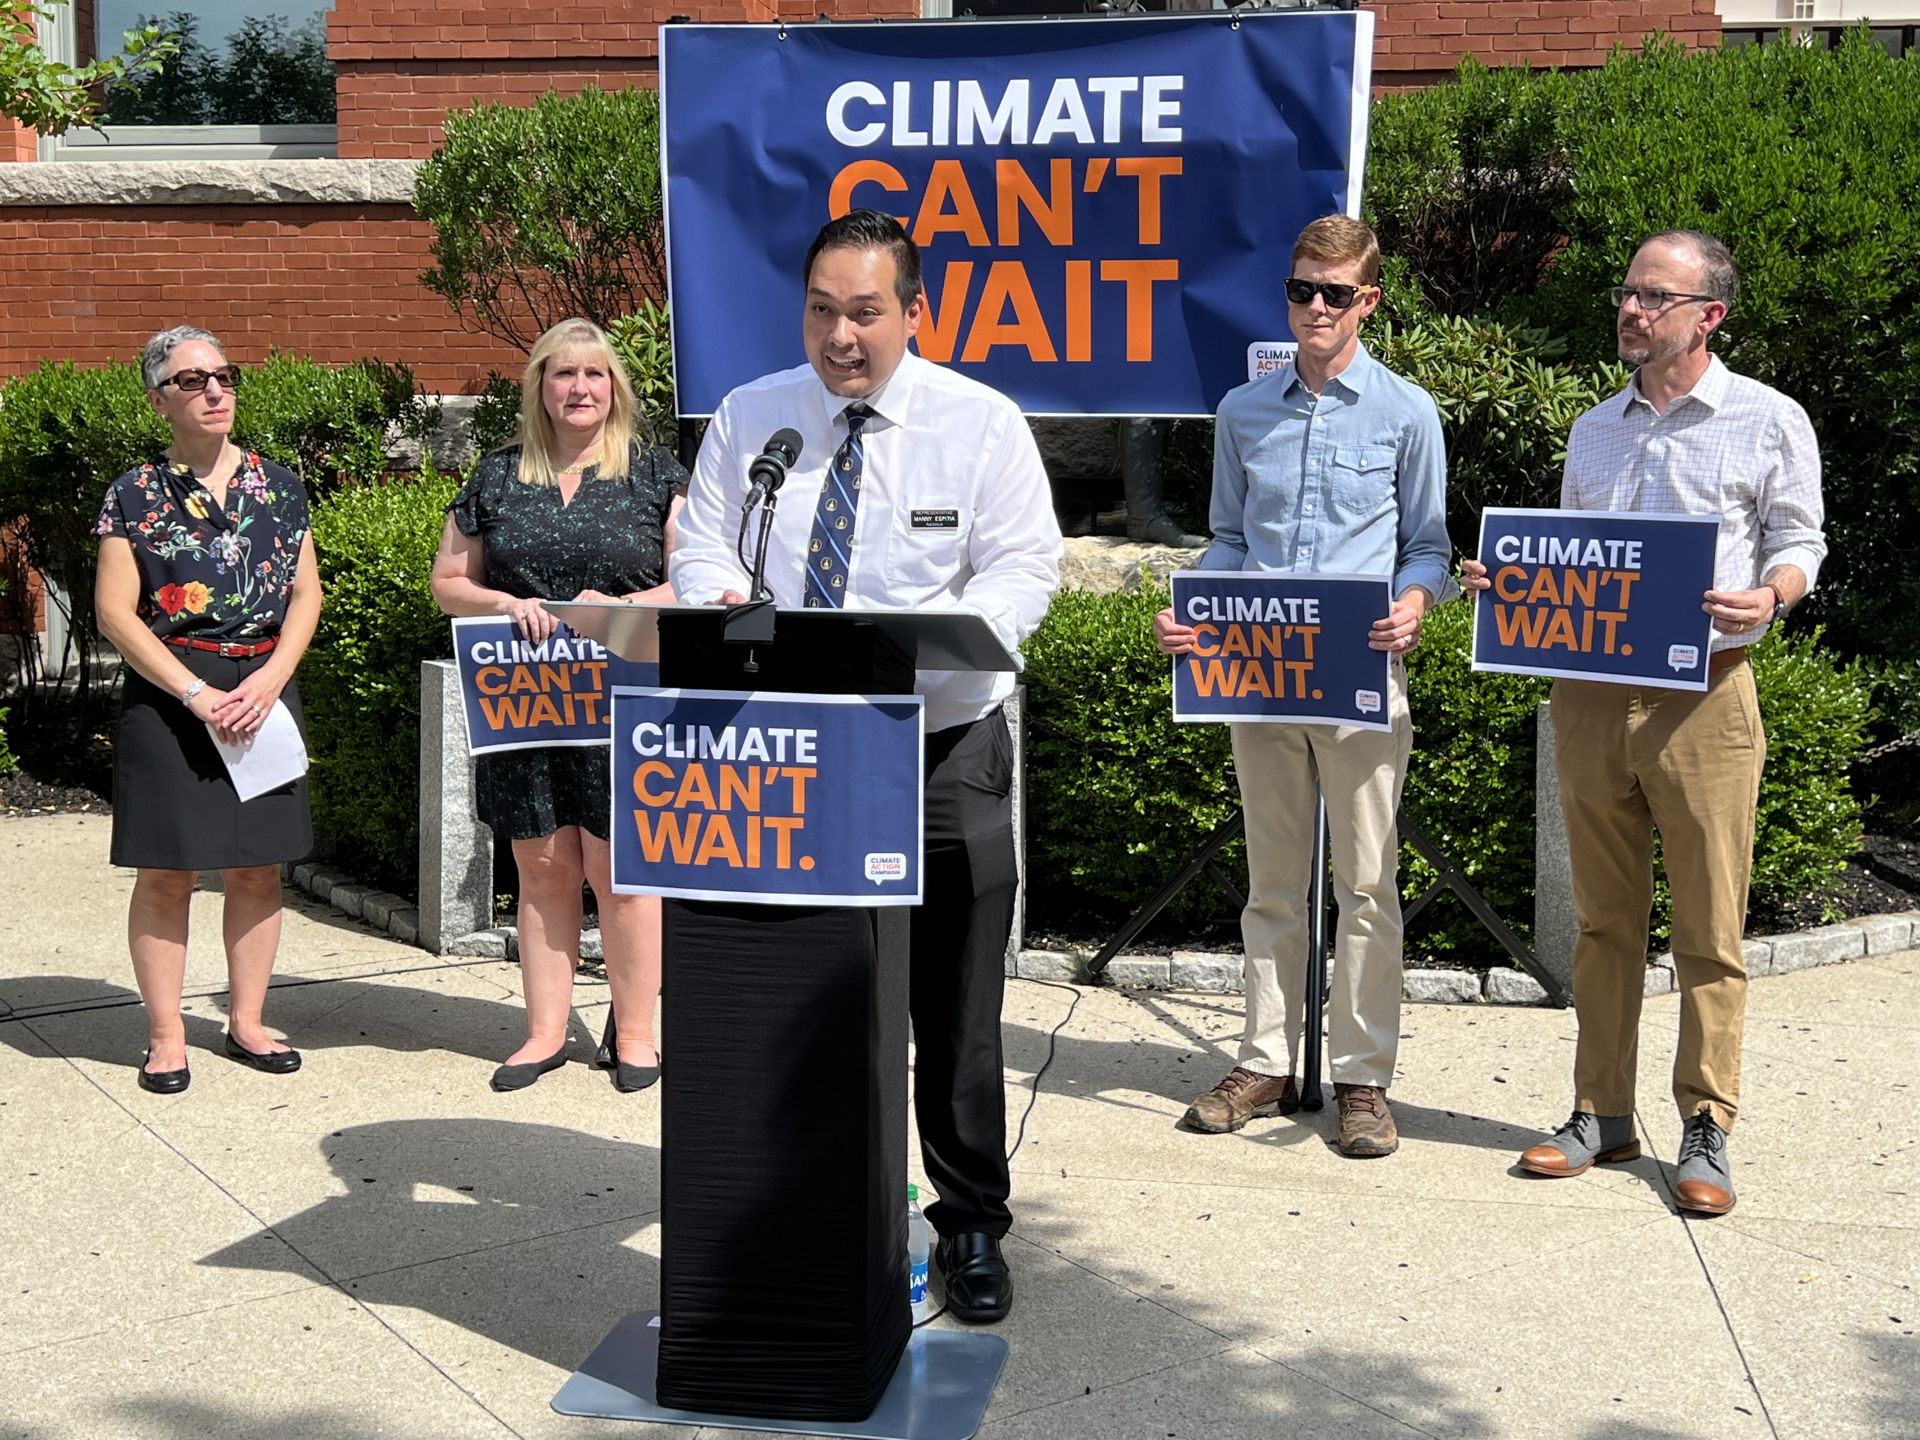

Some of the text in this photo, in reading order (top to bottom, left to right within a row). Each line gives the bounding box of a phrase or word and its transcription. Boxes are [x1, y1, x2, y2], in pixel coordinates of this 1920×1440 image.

[826, 75, 1184, 147] CLIMATE
[828, 157, 1183, 247] CAN'T
[1256, 350, 1298, 360] CLIMAT
[1495, 535, 1643, 569] CLIMATE
[1494, 565, 1641, 610] CAN'T
[1187, 596, 1320, 624] CLIMATE
[1494, 604, 1633, 656] WAIT.
[471, 638, 608, 665] CLIMATE
[1191, 623, 1321, 660] CAN'T
[475, 662, 608, 695] CAN'T
[1189, 658, 1323, 700] WAIT.
[478, 692, 611, 730] WAIT.
[632, 722, 818, 764] CLIMATE
[632, 760, 818, 814] CAN'T
[633, 809, 815, 871] WAIT.
